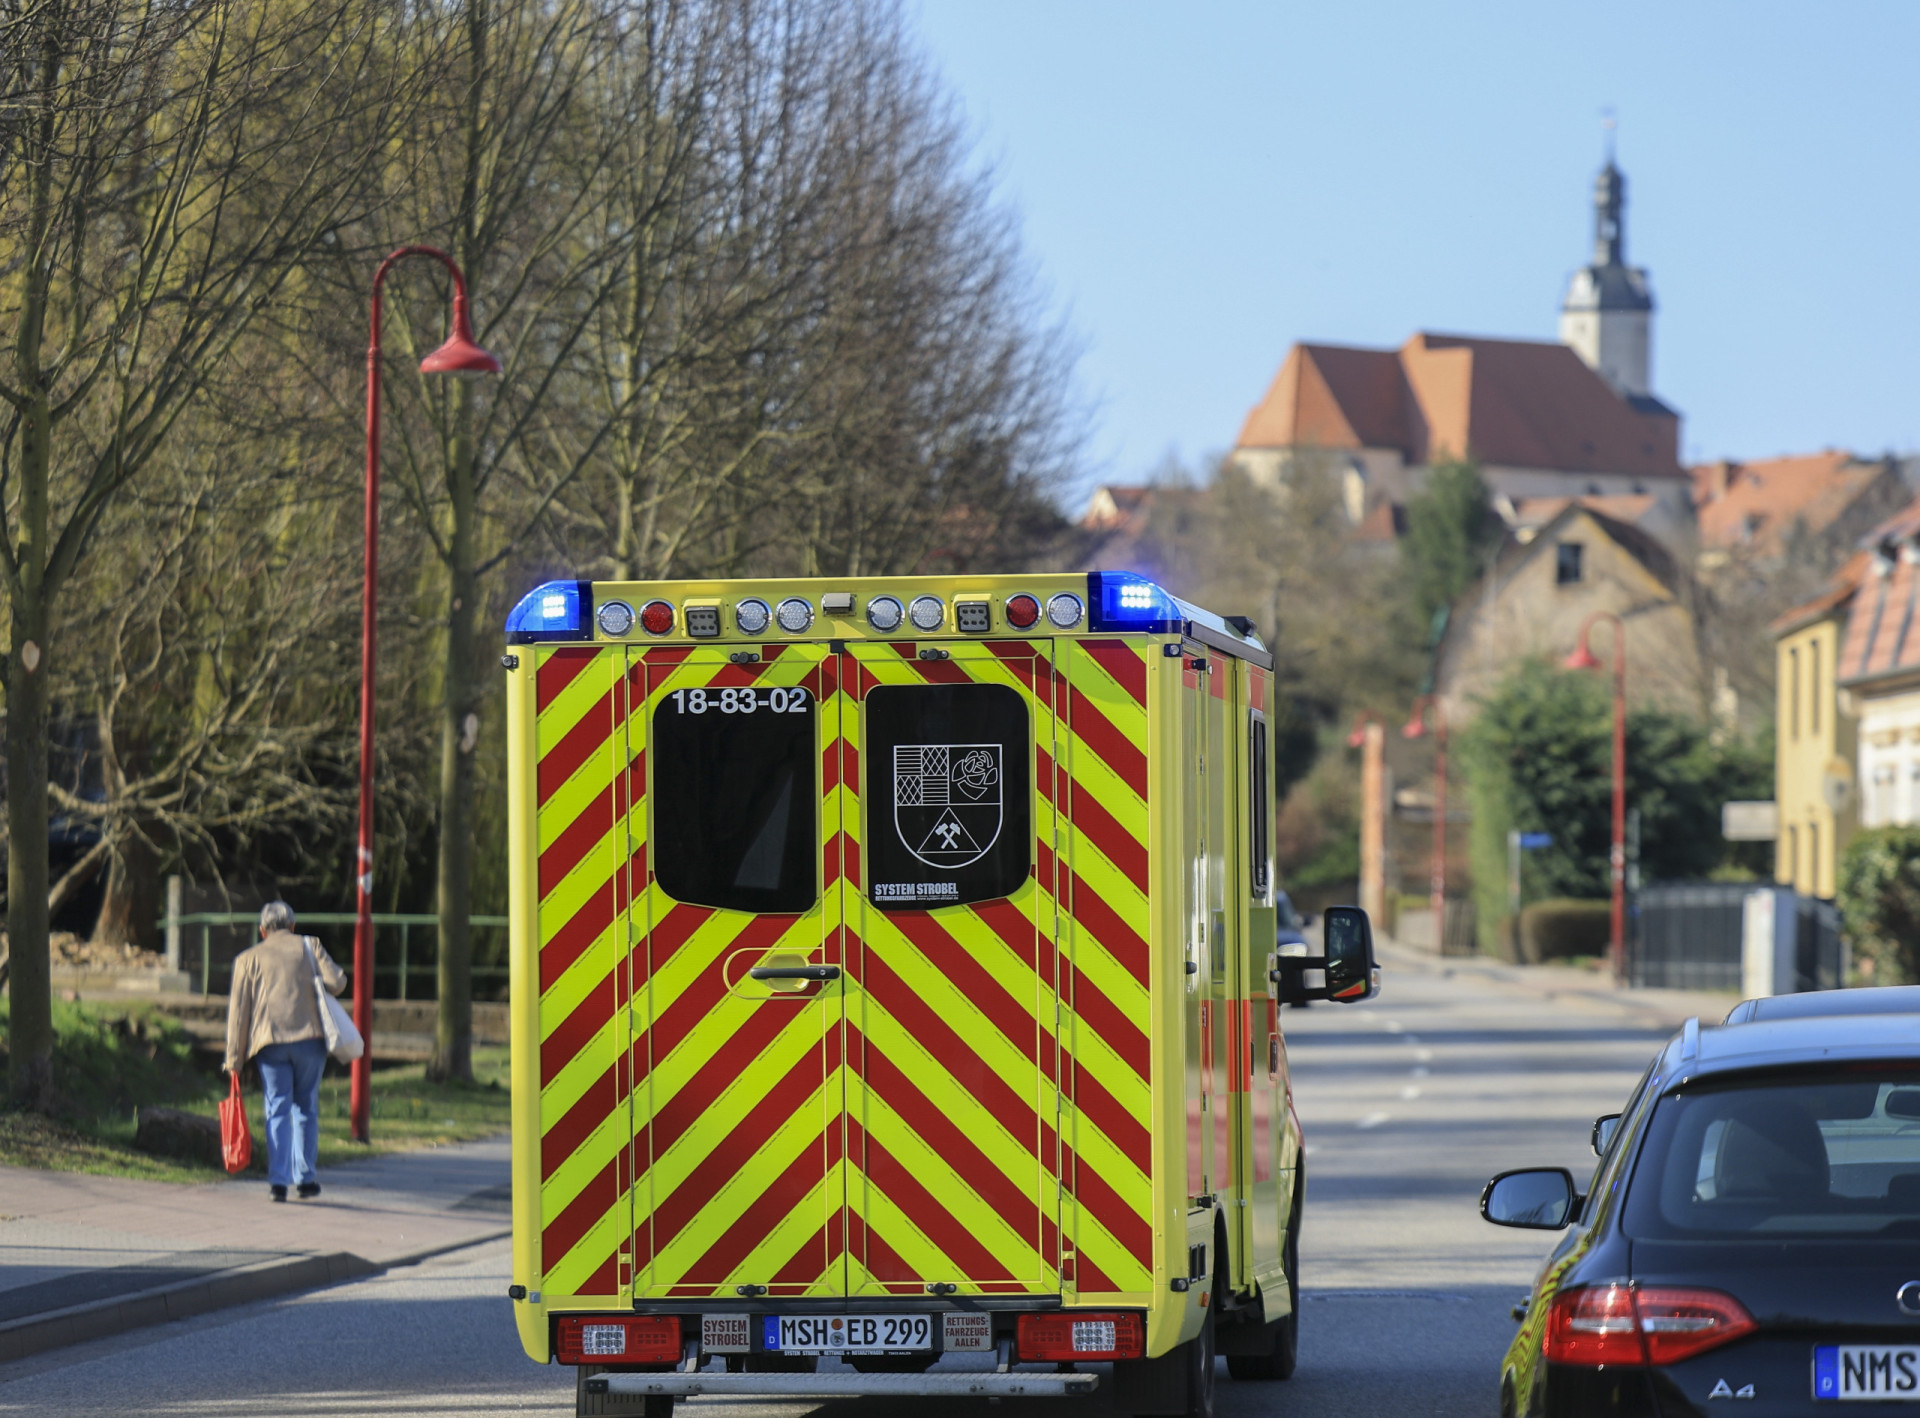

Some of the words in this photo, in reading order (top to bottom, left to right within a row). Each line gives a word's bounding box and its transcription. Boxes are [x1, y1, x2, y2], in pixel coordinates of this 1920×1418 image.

[672, 688, 807, 714] 18-83-02
[875, 883, 915, 896] SYSTEM
[916, 882, 959, 895] STROBEL
[704, 1320, 747, 1333] SYSTEM
[946, 1316, 989, 1326] RETTUNGS-
[781, 1319, 828, 1346] MSH
[847, 1319, 878, 1346] EB
[883, 1318, 928, 1345] 299
[945, 1327, 989, 1337] FAHRZEUGE
[704, 1333, 749, 1346] STROBEL
[768, 1336, 776, 1344] D
[955, 1338, 980, 1347] AALEN
[1843, 1351, 1918, 1392] NMS
[1708, 1378, 1756, 1400] A4
